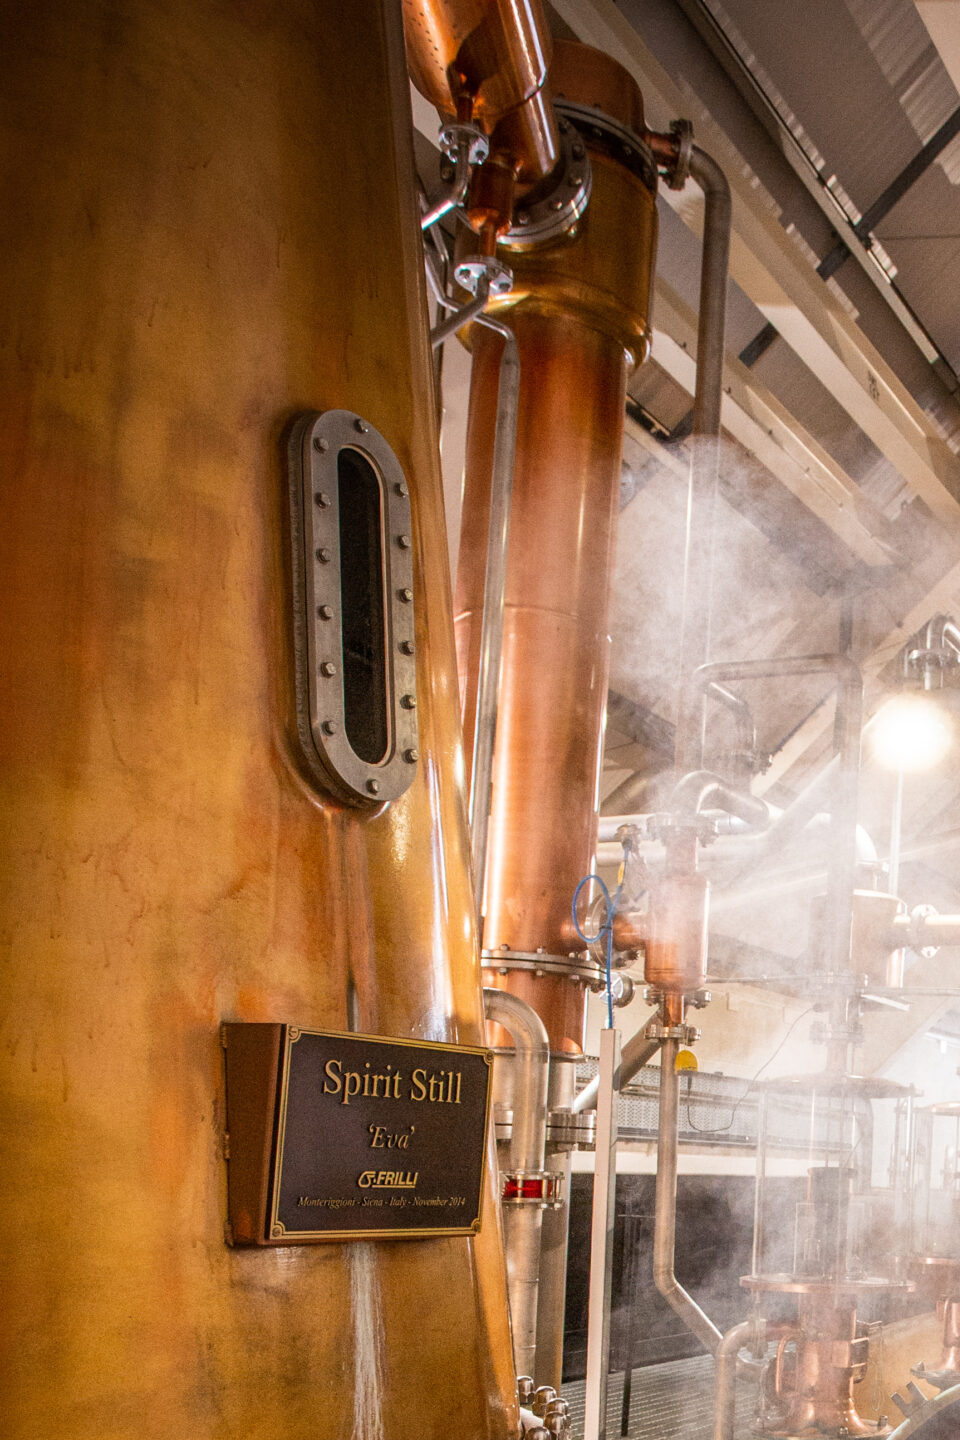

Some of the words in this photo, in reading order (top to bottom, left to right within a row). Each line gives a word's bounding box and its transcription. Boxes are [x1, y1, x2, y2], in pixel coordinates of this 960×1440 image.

[323, 1059, 402, 1105] Spirit
[410, 1068, 462, 1104] Still
[297, 1196, 356, 1209] Monteriggioni
[362, 1196, 384, 1207] Siena
[389, 1196, 407, 1209] Italy
[412, 1196, 448, 1207] November
[448, 1196, 466, 1207] 2014
